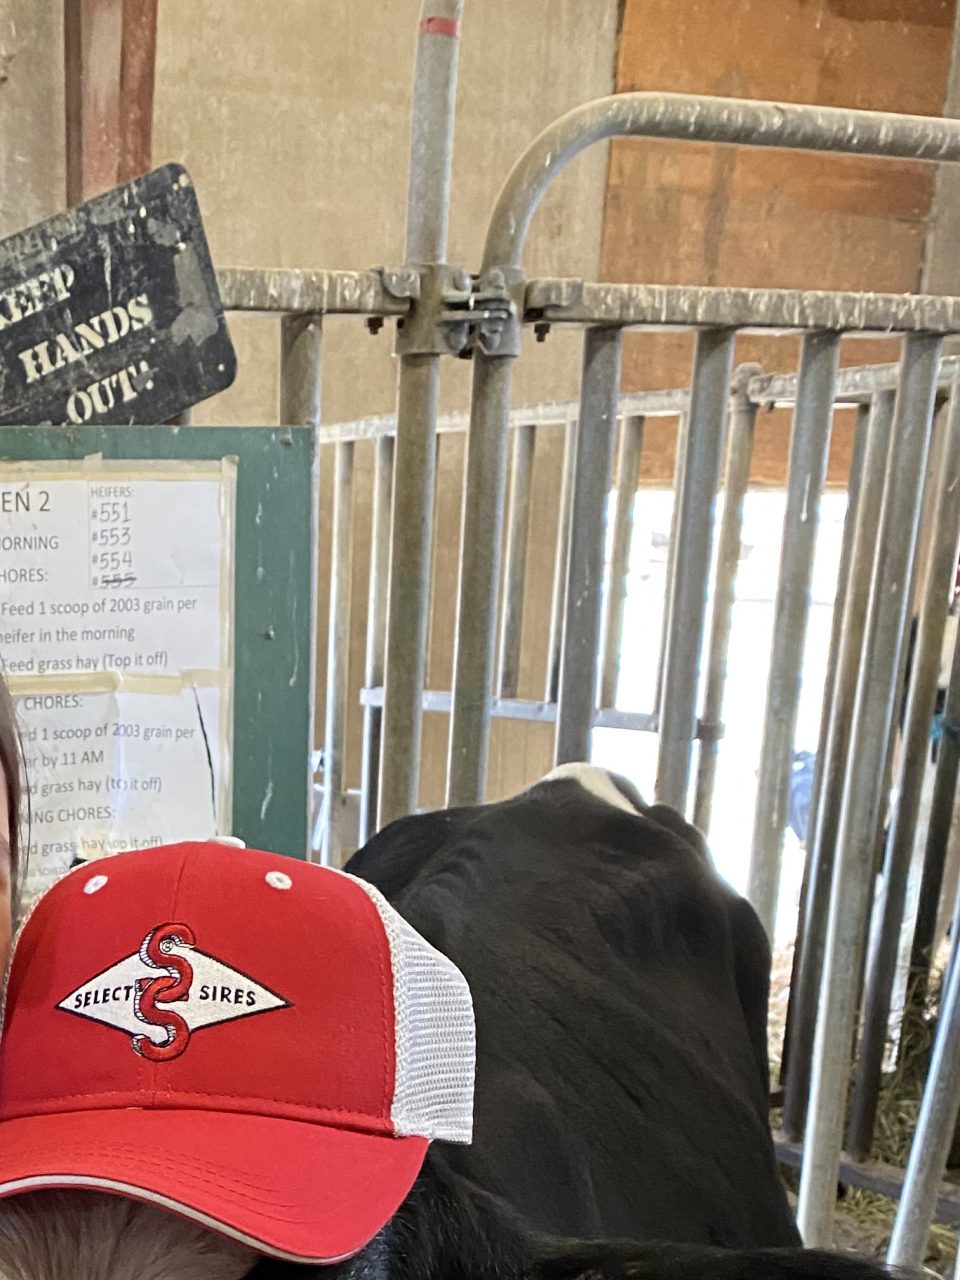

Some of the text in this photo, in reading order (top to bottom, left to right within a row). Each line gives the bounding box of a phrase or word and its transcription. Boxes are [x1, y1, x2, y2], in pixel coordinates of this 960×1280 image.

[17, 292, 154, 384] HANDS
[39, 490, 51, 512] 2
[90, 486, 135, 498] HEIFERS:
[1, 596, 198, 617] Feed 1 scoop of 2003 grain per
[40, 628, 52, 641] in
[56, 627, 77, 642] the
[81, 626, 135, 643] morning
[38, 658, 72, 674] grass
[76, 655, 99, 671] hay
[103, 652, 132, 669] (Top
[135, 652, 144, 667] it
[147, 651, 168, 668] off)
[24, 695, 83, 710] CHORES:
[41, 727, 48, 740] 1
[52, 727, 92, 741] scoop
[95, 723, 109, 737] of
[112, 722, 141, 737] 2003
[143, 723, 173, 741] grain
[175, 727, 195, 741] per
[42, 753, 58, 769] by
[61, 752, 77, 766] 11
[81, 750, 104, 764] AM
[41, 782, 75, 798] grass
[78, 778, 102, 793] hay
[130, 777, 139, 791] it
[141, 776, 162, 793] off)
[58, 806, 116, 822] CHORES:
[81, 837, 105, 851] hay
[74, 985, 256, 1009] SELECT SIRES
